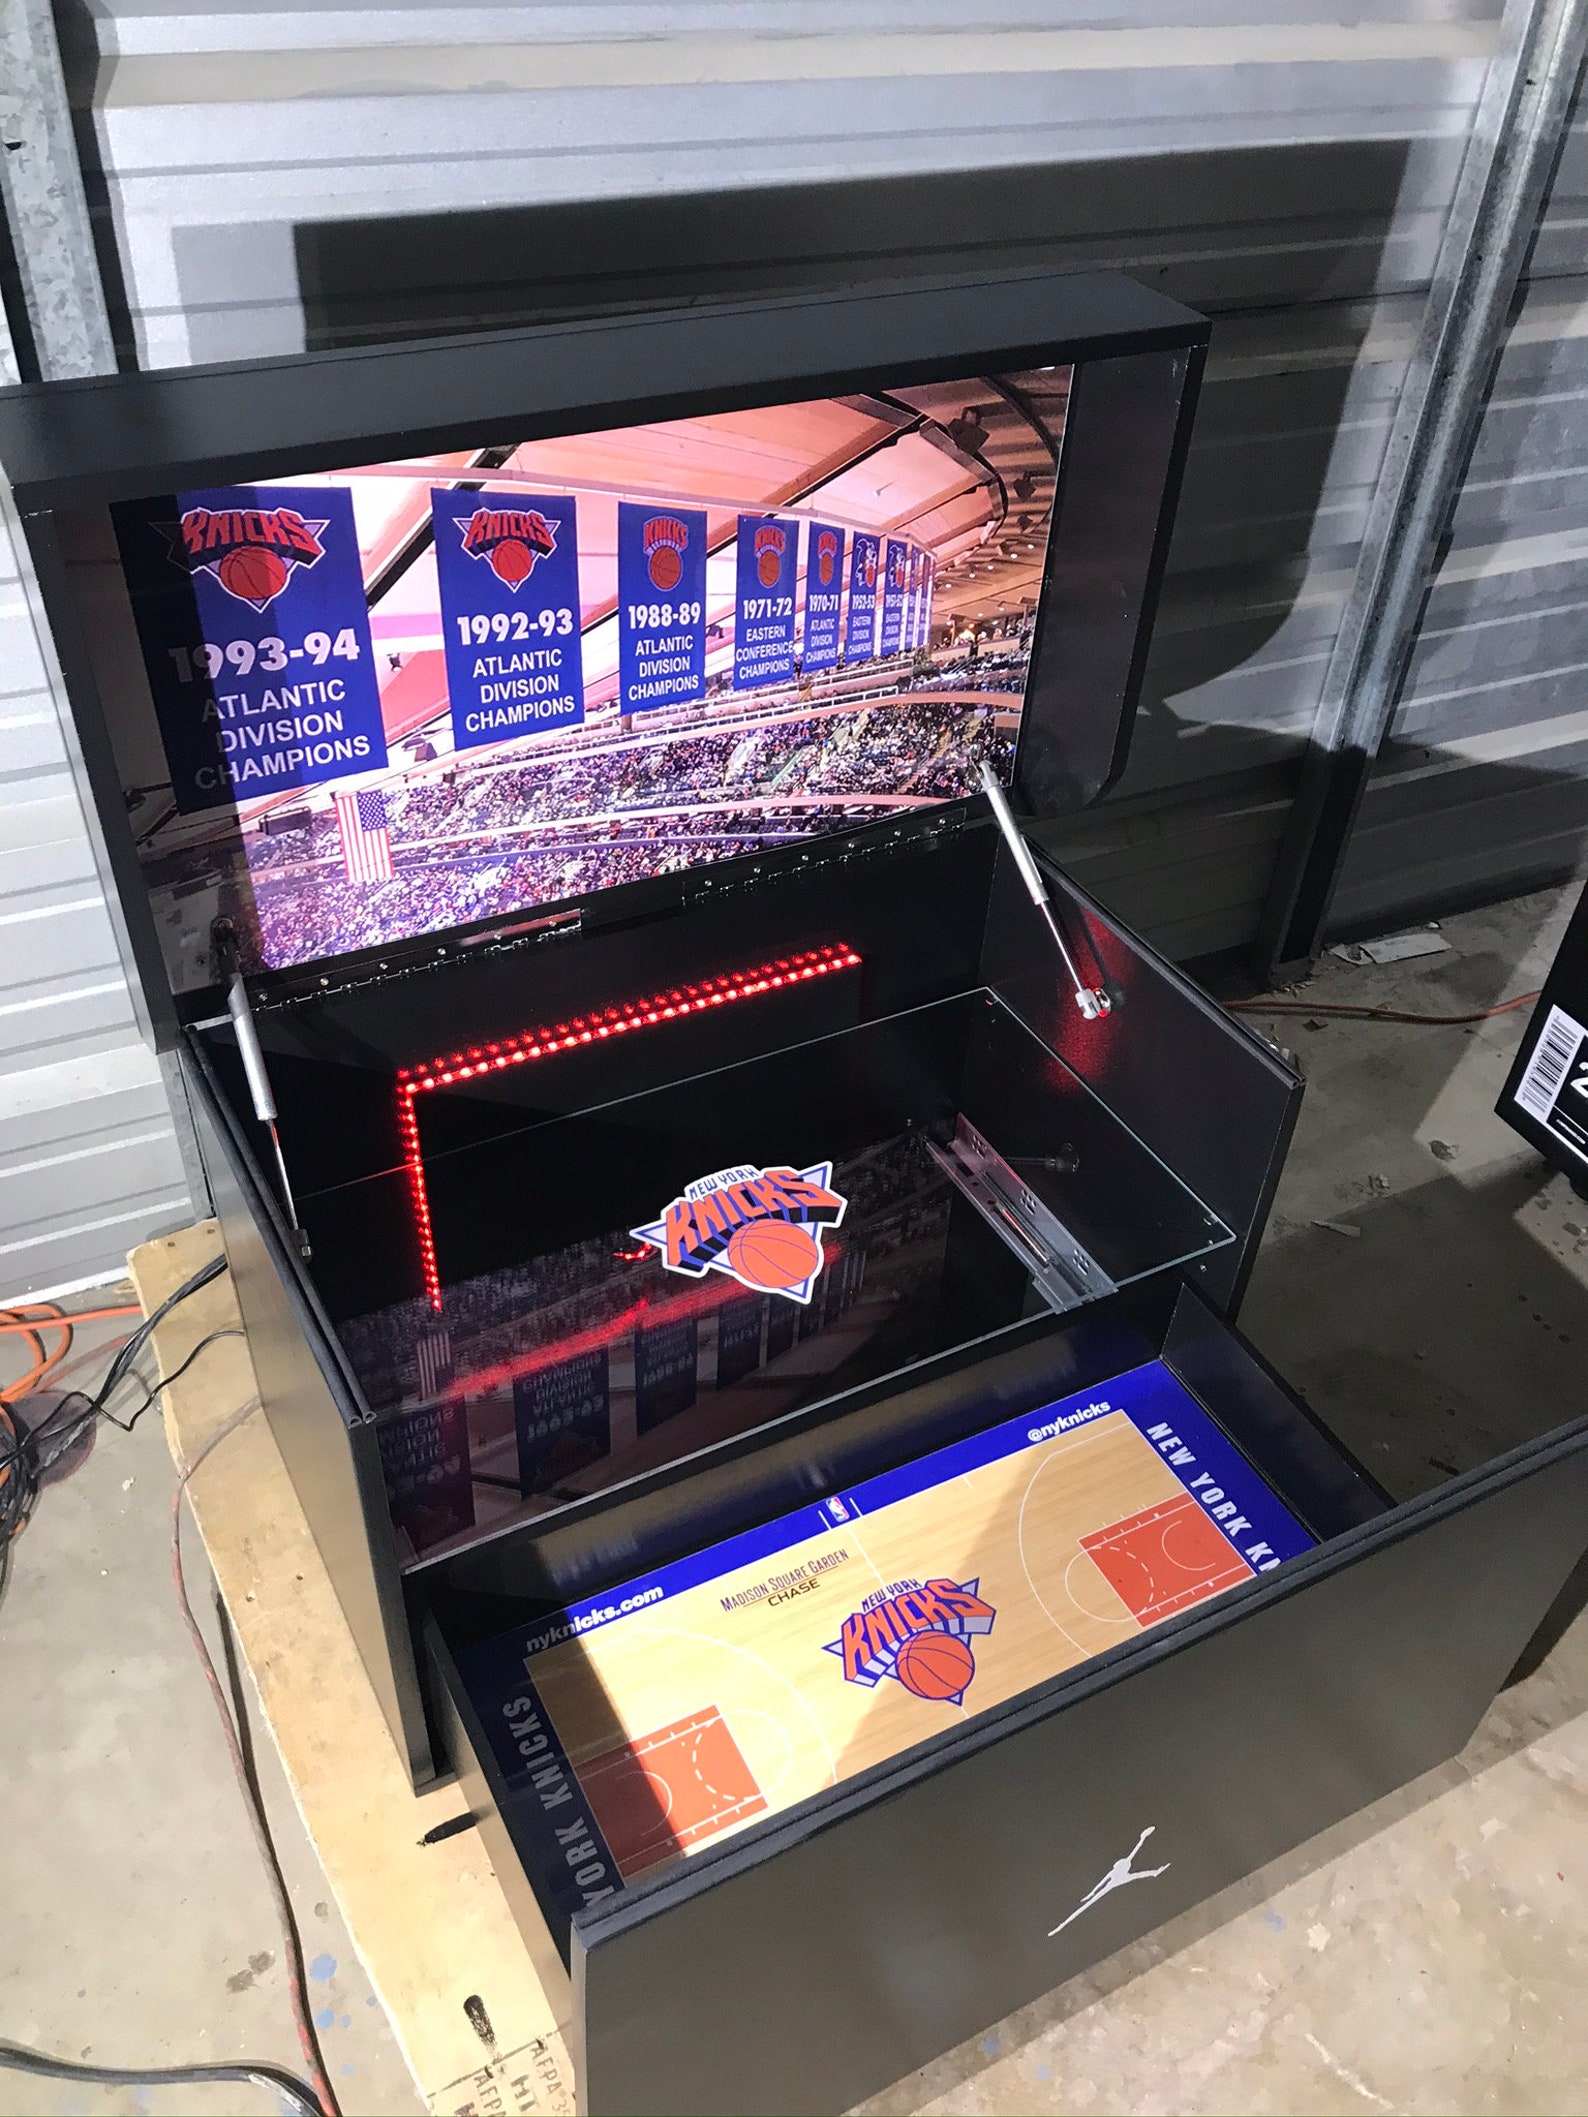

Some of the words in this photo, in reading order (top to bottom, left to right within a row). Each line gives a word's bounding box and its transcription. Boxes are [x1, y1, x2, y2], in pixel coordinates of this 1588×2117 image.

[180, 509, 326, 555] KNICKS
[463, 510, 555, 552] KNICKS
[644, 517, 688, 551] KNICKS
[628, 602, 701, 630] 1988-89
[743, 597, 793, 620] 1971-72
[809, 594, 839, 612] 1970-71
[456, 608, 574, 646] 1992-93
[746, 624, 786, 642] EASTERN
[810, 618, 835, 632] ATLANTIC
[168, 628, 360, 683] 1993-94
[472, 648, 563, 678] ATLANTIC
[635, 635, 694, 657] ATLANTIC
[736, 640, 794, 662] CONFERENCE
[806, 647, 836, 664] CHAMPIONS
[639, 656, 690, 678] DIVISION
[739, 658, 790, 680] CHAMPIONS
[202, 679, 346, 723] ATLANTIC
[480, 674, 560, 704] DIVISION
[628, 675, 699, 701] CHAMPIONS
[465, 695, 575, 732] CHAMPIONS
[216, 710, 343, 754] DIVISION
[194, 735, 371, 790] CHAMPIONS
[689, 1178, 718, 1200] NEW
[720, 1166, 759, 1187] YORK
[666, 1169, 843, 1267] KNICKS
[1027, 1401, 1111, 1442] @nyknicks
[1146, 1422, 1197, 1466] NEW
[1190, 1472, 1252, 1537] YORK
[720, 1583, 769, 1612] MADISON
[768, 1566, 809, 1591] SQUARE
[807, 1549, 849, 1574] GARDEN
[768, 1578, 820, 1607] CHASE
[861, 1589, 887, 1613] NEW
[888, 1578, 922, 1598] YORK
[526, 1586, 664, 1652] nyknicks.com
[841, 1578, 996, 1682] KNICKS
[502, 1696, 573, 1811] KNICKS
